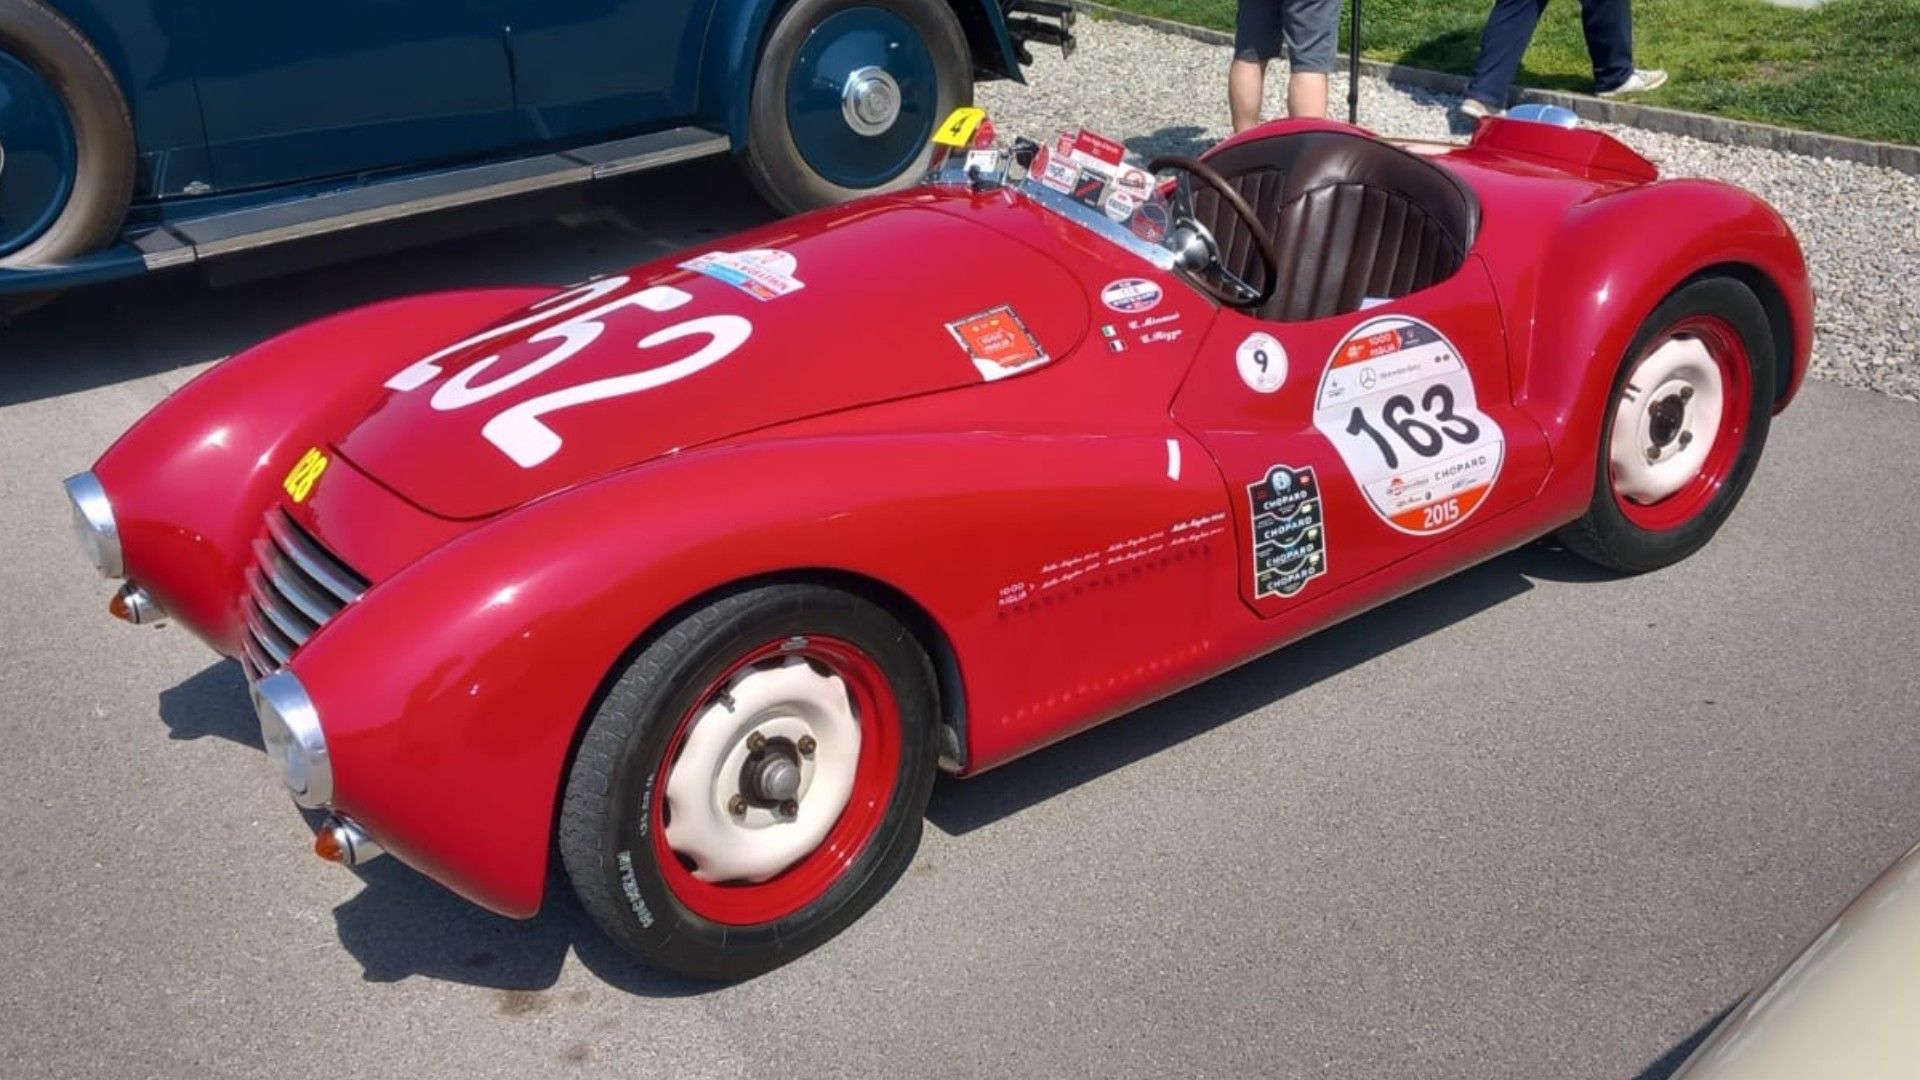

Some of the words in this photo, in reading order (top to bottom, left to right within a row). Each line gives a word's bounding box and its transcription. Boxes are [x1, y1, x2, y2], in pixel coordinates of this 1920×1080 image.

[949, 115, 970, 137] 4
[384, 275, 752, 468] 252
[1253, 349, 1268, 373] 9
[1346, 384, 1480, 469] 163
[1434, 456, 1487, 481] CHOPARD
[1263, 490, 1307, 510] CHOPARD
[1423, 499, 1460, 528] 2015
[1264, 516, 1312, 539] CHOPARD
[1266, 543, 1314, 567] CHOPARD
